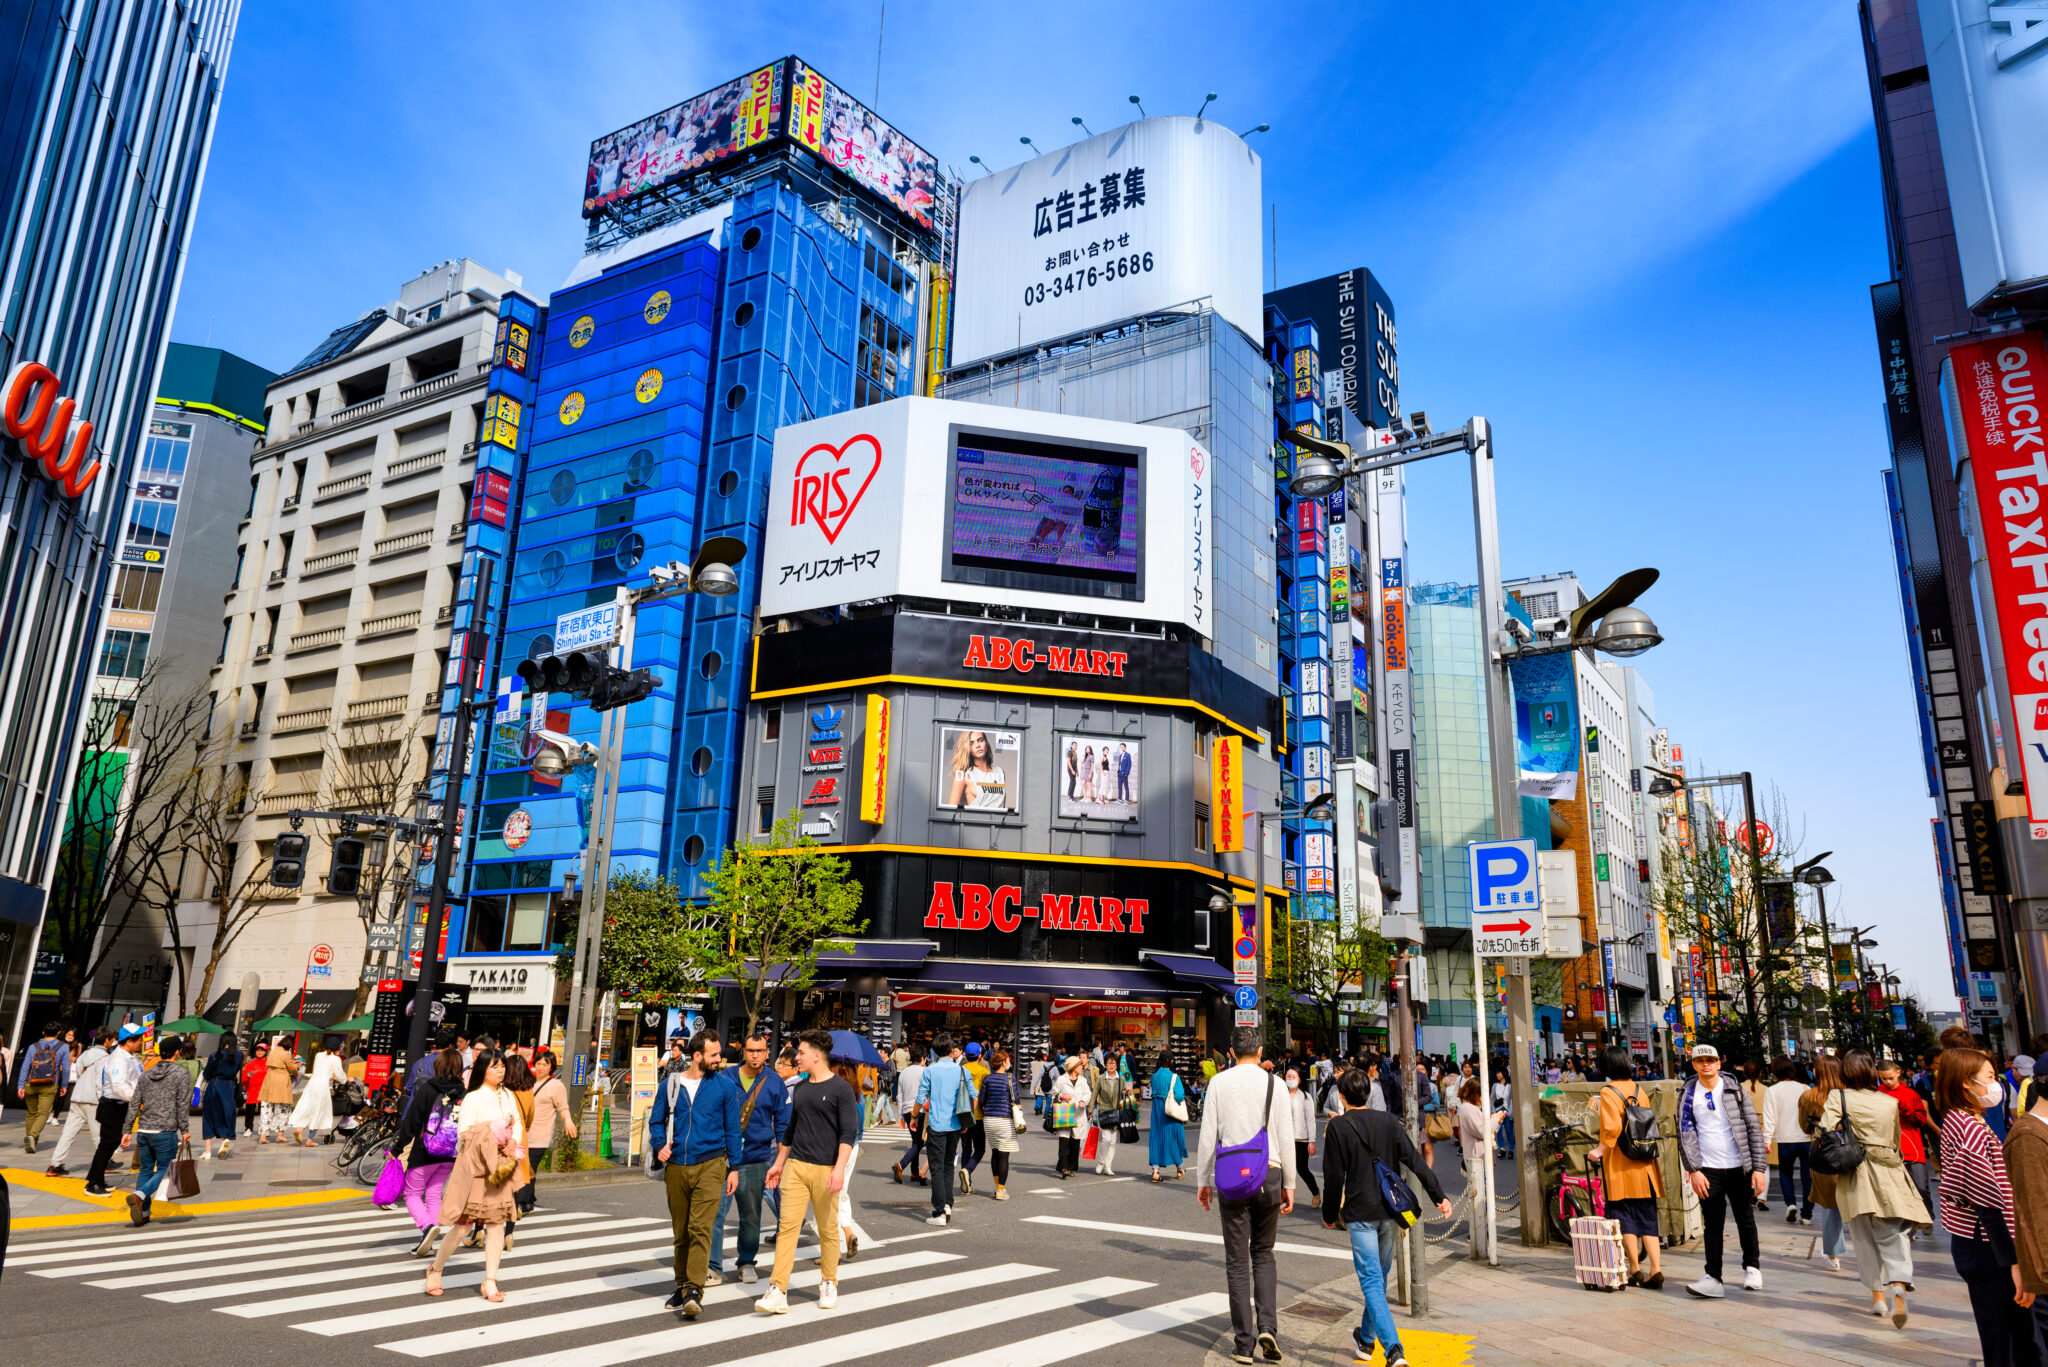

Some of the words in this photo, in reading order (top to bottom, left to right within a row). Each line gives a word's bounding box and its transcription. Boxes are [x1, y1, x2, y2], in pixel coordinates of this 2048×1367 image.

[754, 70, 771, 117] 3F
[806, 74, 822, 117] 3F
[1033, 167, 1146, 239] 広告主募集
[1045, 232, 1130, 271] お問い合わせ
[1024, 252, 1154, 306] 03-3476-5686
[1338, 270, 1355, 303] THE
[1339, 306, 1356, 341] SUIT
[1973, 360, 2006, 446] 快速免税手续
[1997, 346, 2045, 452] QUICK
[1, 361, 101, 498] au
[790, 467, 852, 528] IRIS
[964, 477, 1022, 492] 色が変われば
[1382, 479, 1396, 490] 9F
[779, 549, 880, 585] アイリスオーヤマ
[1193, 483, 1203, 625] アイリスオーヤマ
[1385, 560, 1399, 570] 5F
[1384, 588, 1402, 602] 本
[1386, 577, 1401, 587] 7F
[111, 614, 148, 626] EDDING
[559, 607, 614, 635] 新宿駅東口
[1334, 612, 1346, 621] 4F
[556, 632, 587, 650] Shinjuku
[963, 635, 1128, 677] ABC-MART
[1304, 661, 1317, 670] 5F
[1339, 640, 1349, 689] Euphoria
[1391, 683, 1405, 735] KEYUCA
[810, 731, 842, 742] adidas
[810, 747, 842, 763] VANS
[875, 700, 888, 819] ABC-MART
[1396, 752, 1404, 769] THE
[1397, 770, 1405, 787] SUIT
[1591, 756, 1601, 798] 三井住友銀行
[815, 796, 839, 804] balance
[1220, 739, 1232, 849] ABC-MART
[1398, 787, 1408, 825] COMPANY
[801, 822, 830, 835] PUMA
[1402, 832, 1410, 866] WHITE
[1971, 803, 1996, 892] COACH
[1311, 869, 1322, 878] 3F
[1476, 846, 1530, 907] P
[923, 881, 1149, 934] ABC-MART
[1497, 891, 1535, 905] 駐車場
[371, 926, 396, 935] MOA
[1476, 937, 1540, 953] この先50m右折
[365, 965, 379, 974] モア
[964, 983, 991, 991] ABC-MART
[1240, 991, 1249, 1006] P
[963, 1000, 987, 1009] OPEN
[1117, 1006, 1140, 1015] OPEN
